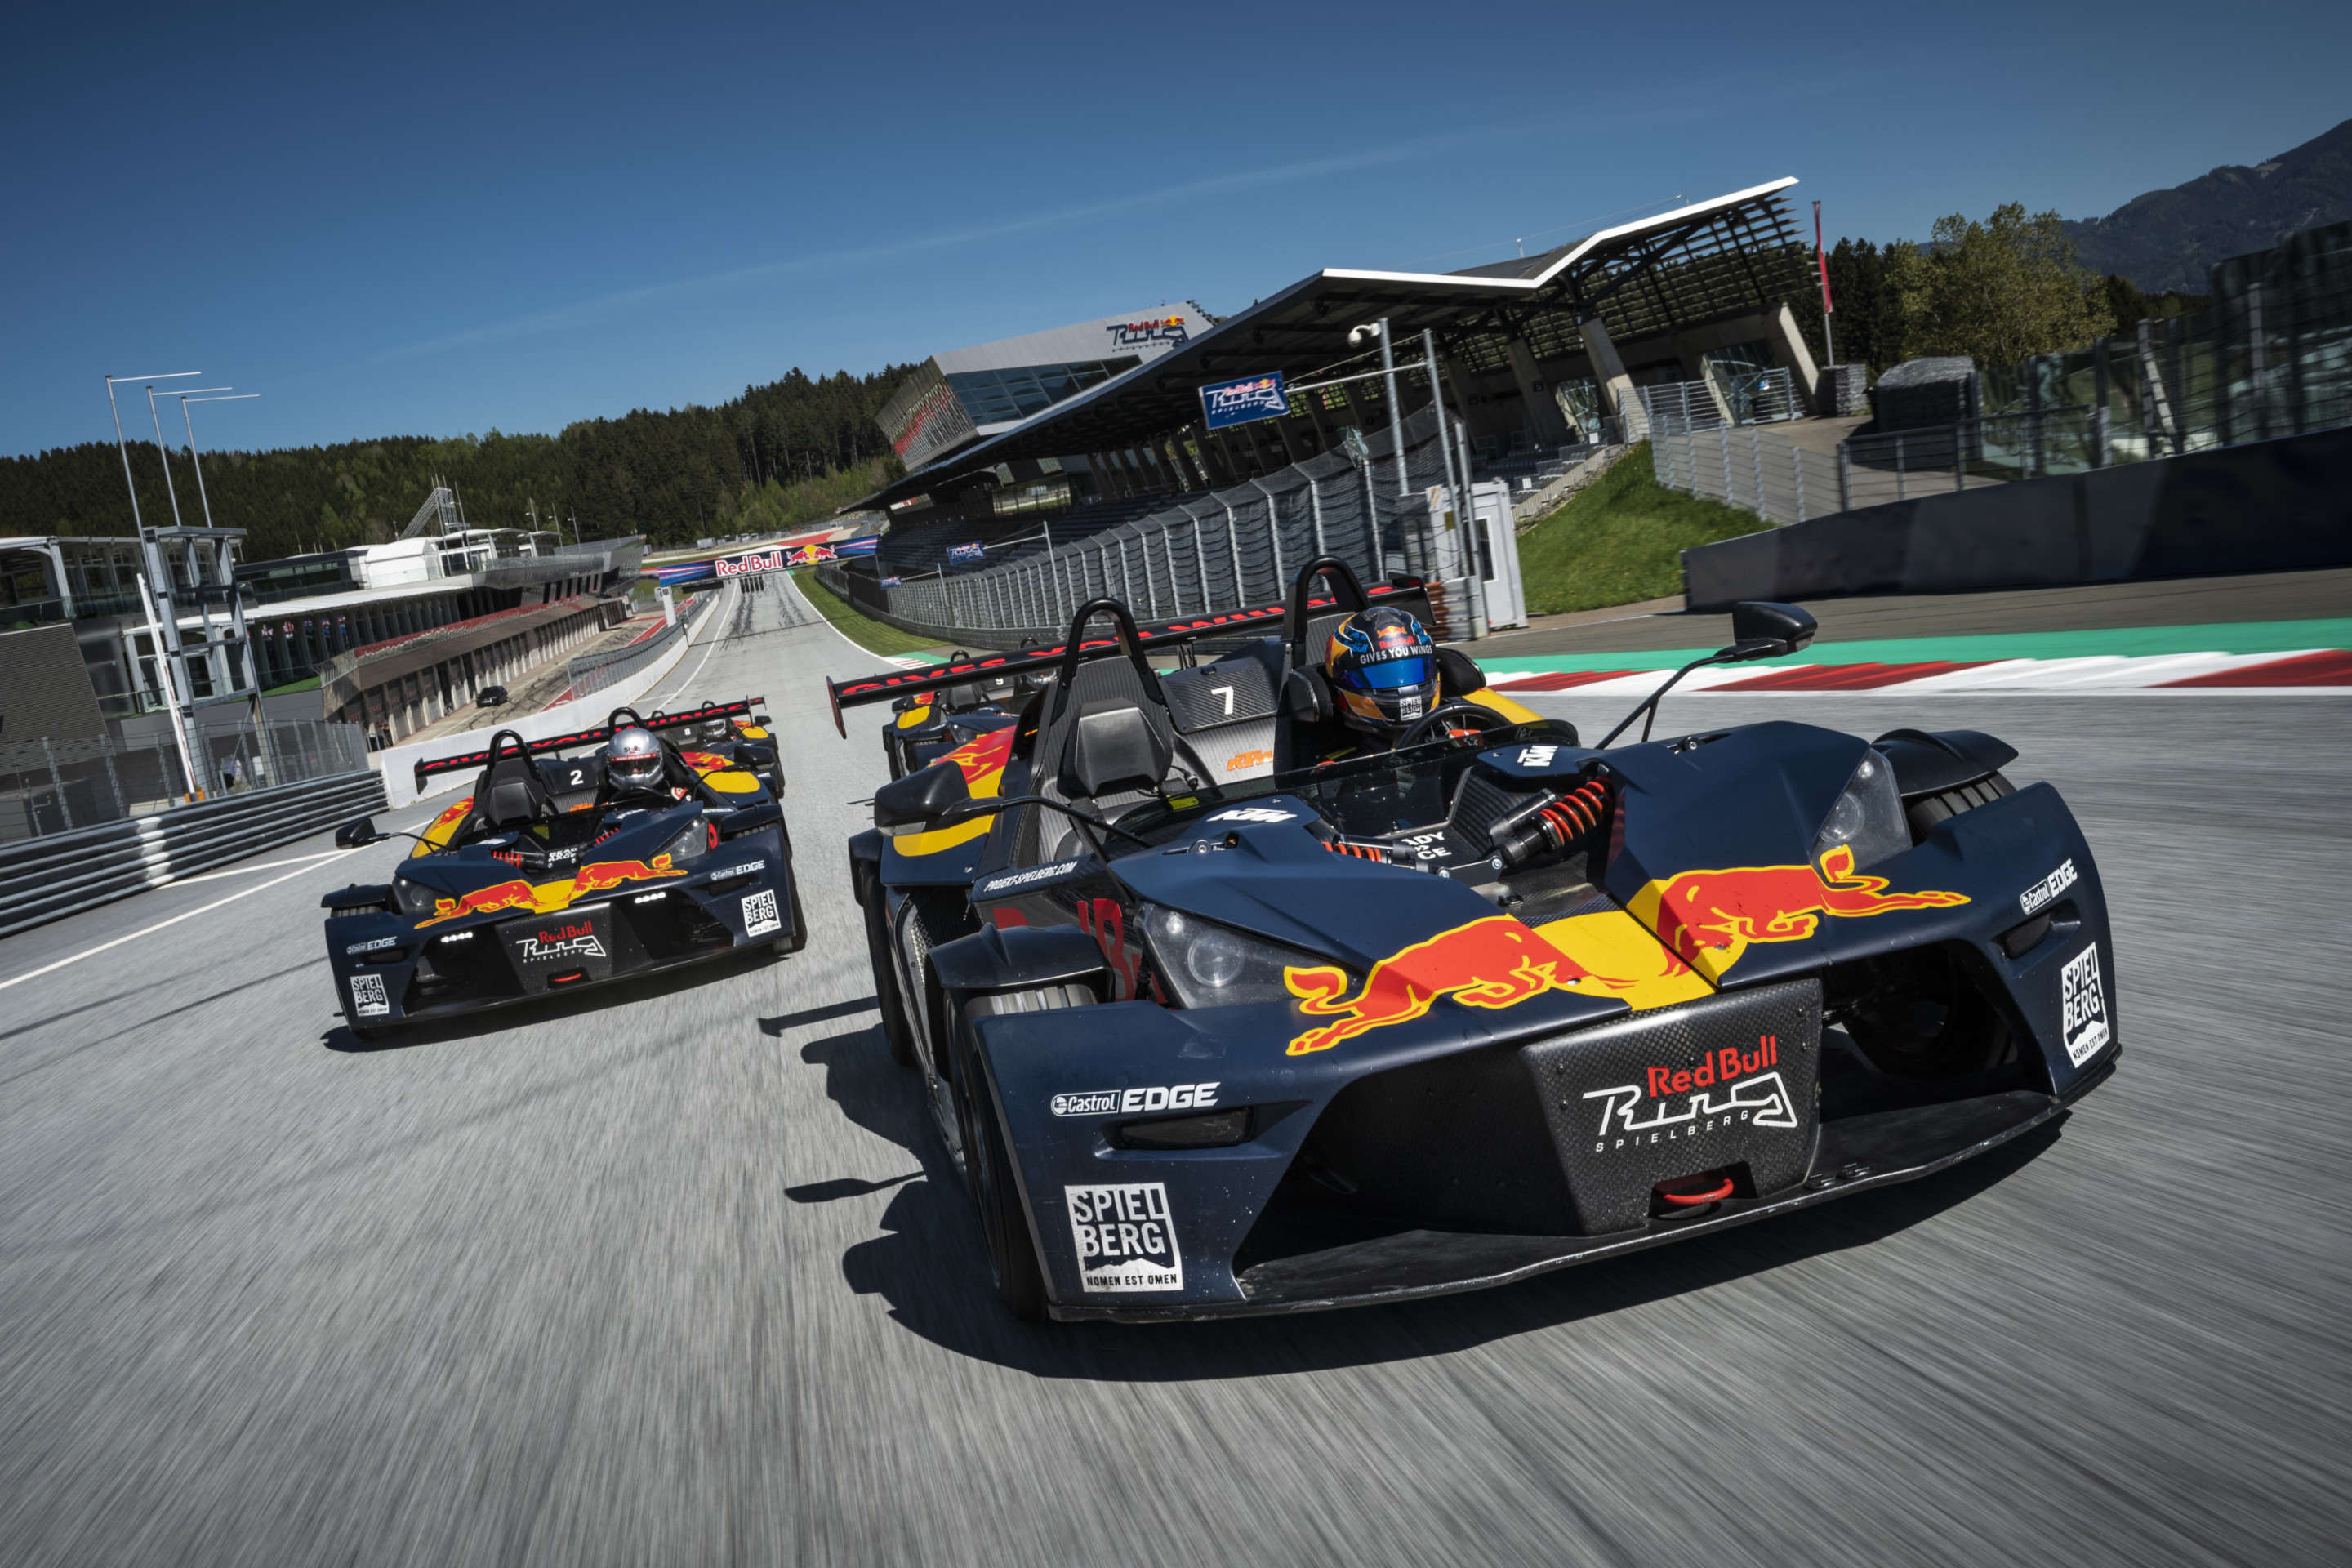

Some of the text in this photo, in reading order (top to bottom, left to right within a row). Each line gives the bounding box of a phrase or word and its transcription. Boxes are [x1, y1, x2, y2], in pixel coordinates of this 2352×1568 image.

[715, 550, 783, 577] Red Bull
[1379, 637, 1398, 649] Red
[1397, 635, 1415, 646] Bull
[1359, 644, 1432, 664] GIVES YOU WINGS
[1210, 686, 1234, 715] 7
[684, 728, 691, 736] 8
[1227, 750, 1273, 772] KTM
[570, 769, 584, 786] 2
[1401, 831, 1446, 846] ADY
[736, 860, 766, 875] EDGE
[983, 861, 1078, 893] PROJEKT-SPIELBERG.COM
[2029, 858, 2078, 909] Castrol EDGE
[743, 892, 775, 914] SPIEL
[746, 905, 775, 924] BERG
[538, 920, 594, 944] Red Bull
[367, 936, 398, 951] EDGE
[352, 976, 382, 991] SPIEL
[2064, 947, 2098, 1000] SPIEL
[355, 988, 385, 1004] BERG
[2064, 982, 2101, 1034] BERG
[2072, 1040, 2090, 1062] NOMEN
[1646, 1034, 1778, 1098] Red Bull
[1067, 1082, 1221, 1114] Castrol EDGE
[1595, 1109, 1749, 1152] SPIELBERG
[1072, 1187, 1165, 1223] SPIEL
[1076, 1222, 1166, 1258] BERG
[1086, 1273, 1178, 1286] NOMEN EST OMEN
